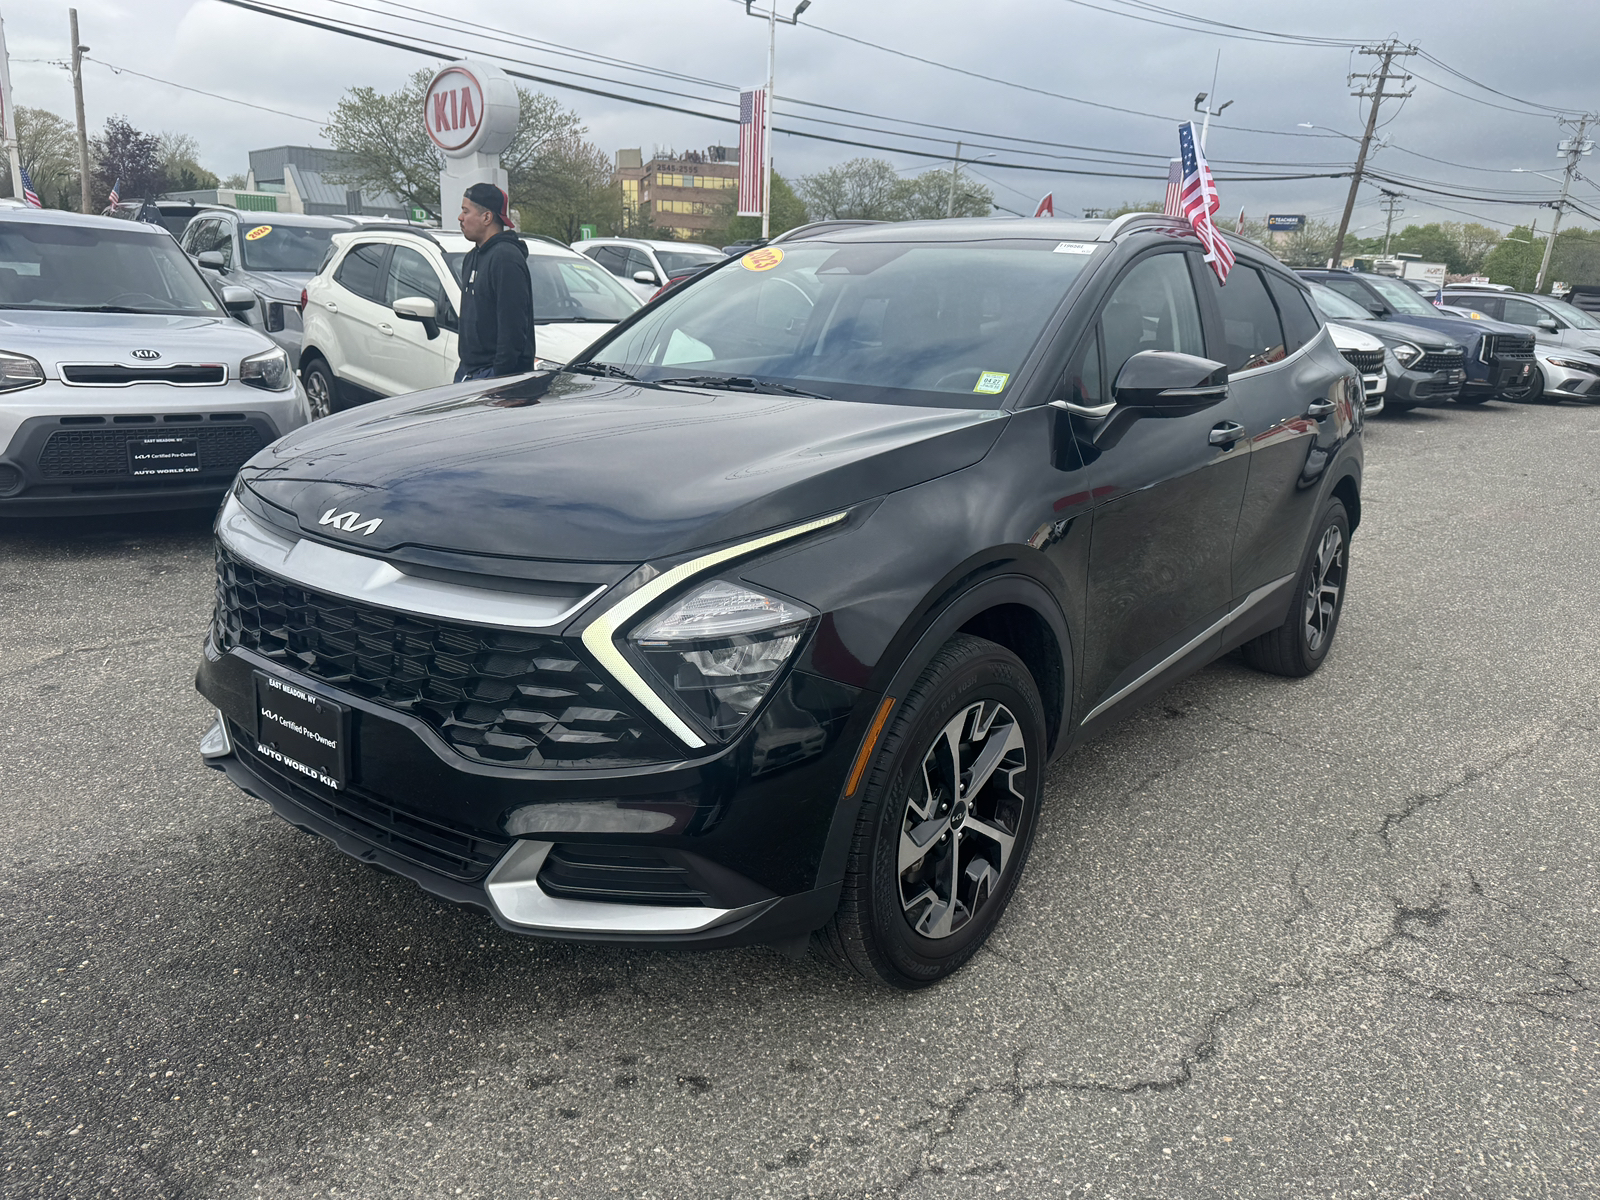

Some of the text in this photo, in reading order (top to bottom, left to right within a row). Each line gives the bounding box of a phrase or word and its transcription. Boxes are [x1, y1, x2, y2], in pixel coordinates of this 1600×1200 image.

[433, 87, 476, 132] KIA
[412, 209, 426, 219] TD
[248, 226, 269, 238] 2024
[746, 249, 778, 268] 2023
[135, 350, 157, 358] KIA
[268, 678, 281, 689] EAST
[307, 695, 316, 704] NY
[279, 716, 303, 734] Certified
[257, 744, 338, 790] AUTO WORLD KIA
